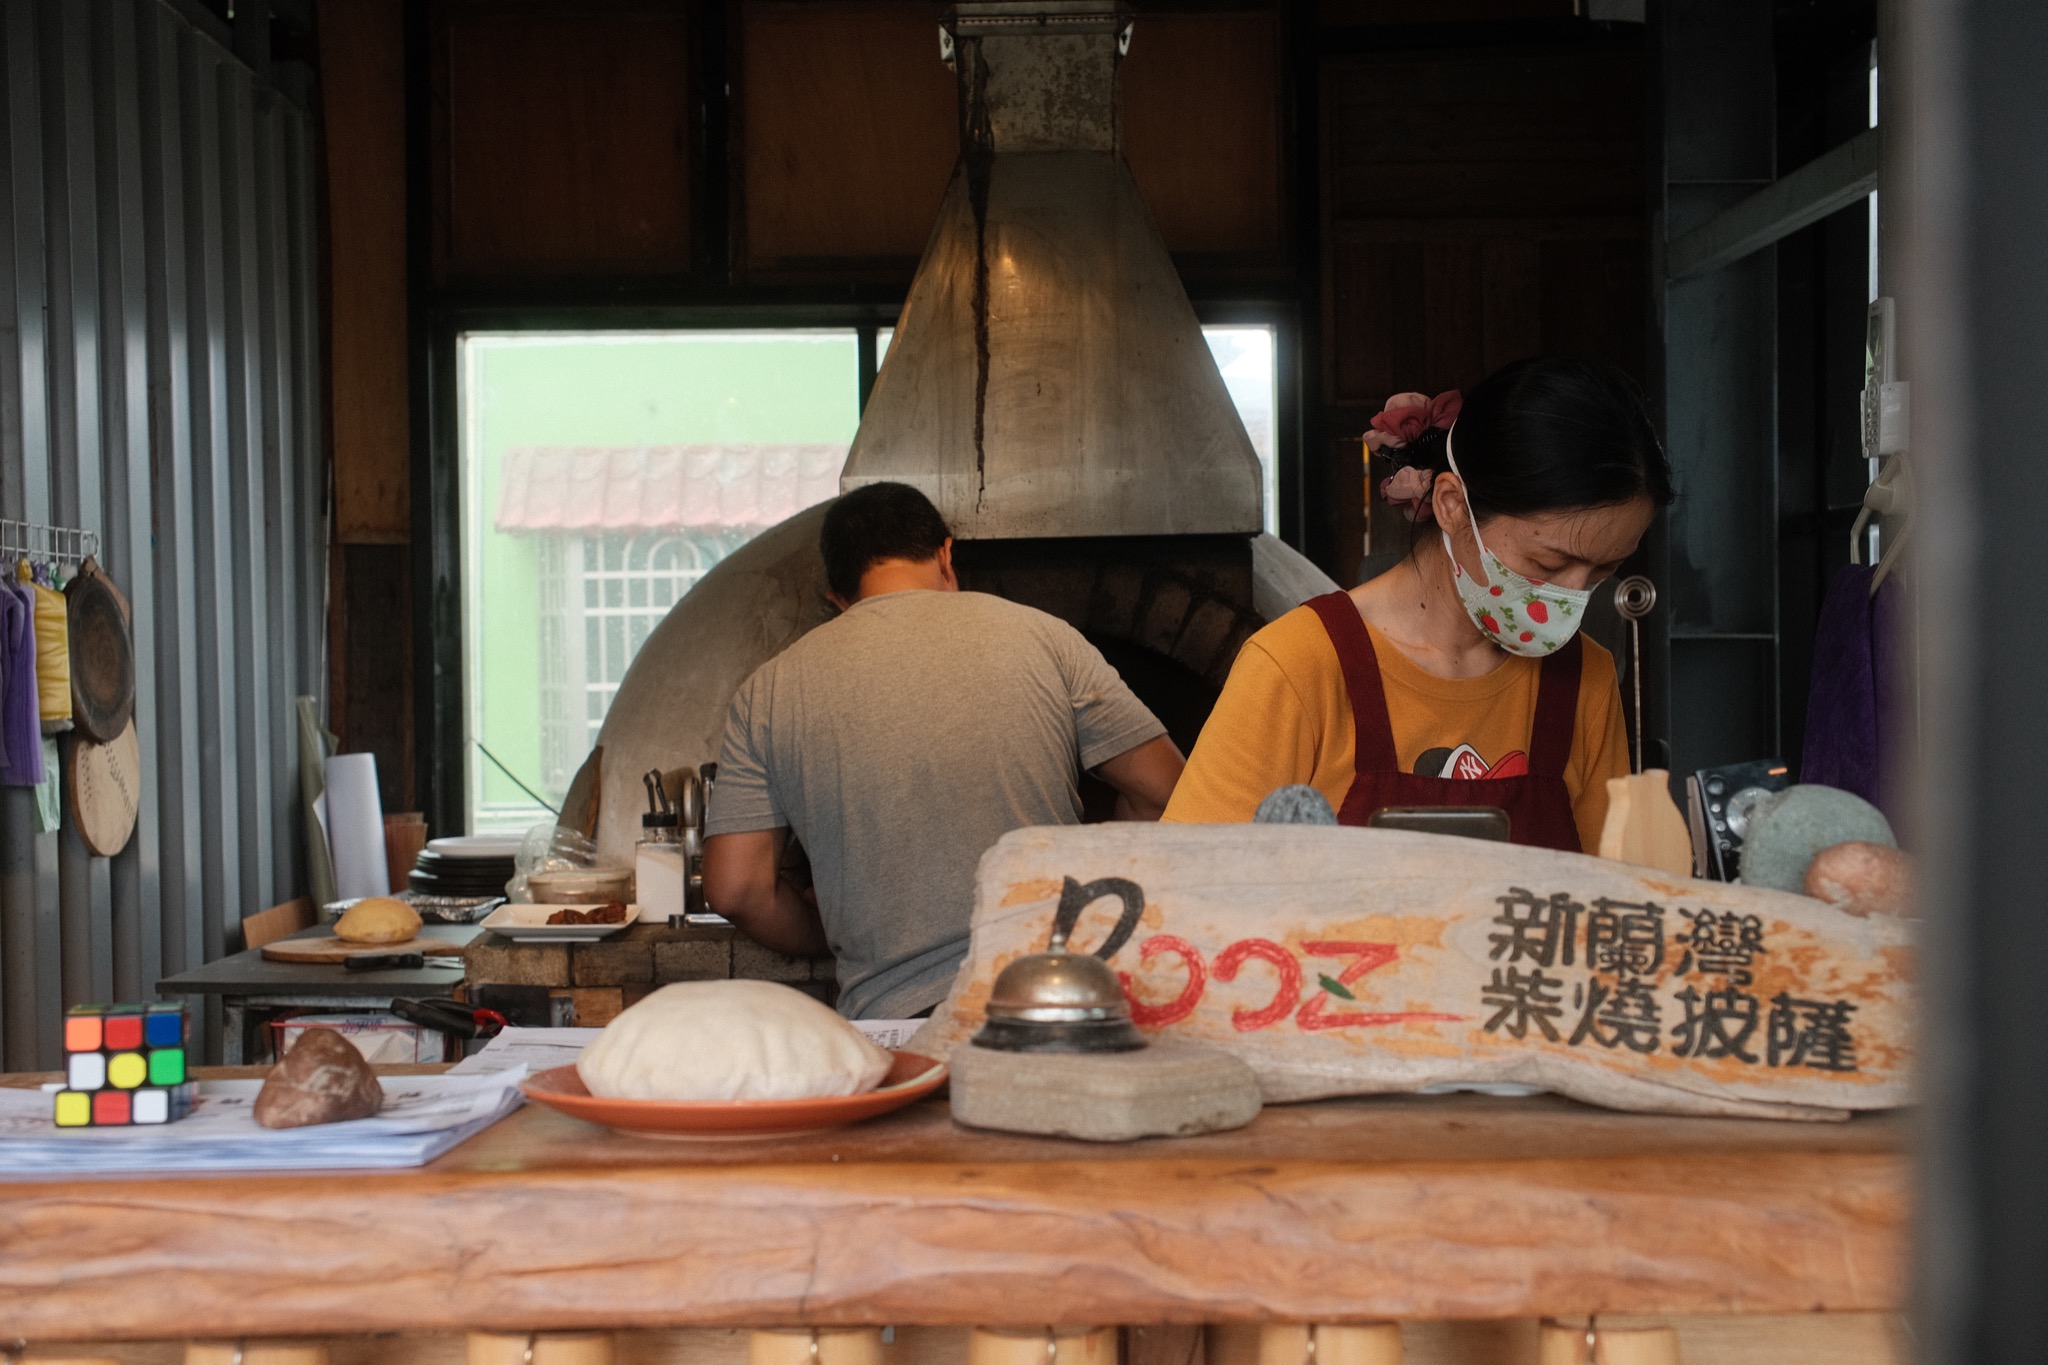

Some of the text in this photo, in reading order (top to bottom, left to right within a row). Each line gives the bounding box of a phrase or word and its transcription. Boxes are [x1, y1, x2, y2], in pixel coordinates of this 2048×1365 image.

[1488, 887, 1768, 986] 新蘭灣
[1482, 966, 1858, 1072] 柴燒披薩
